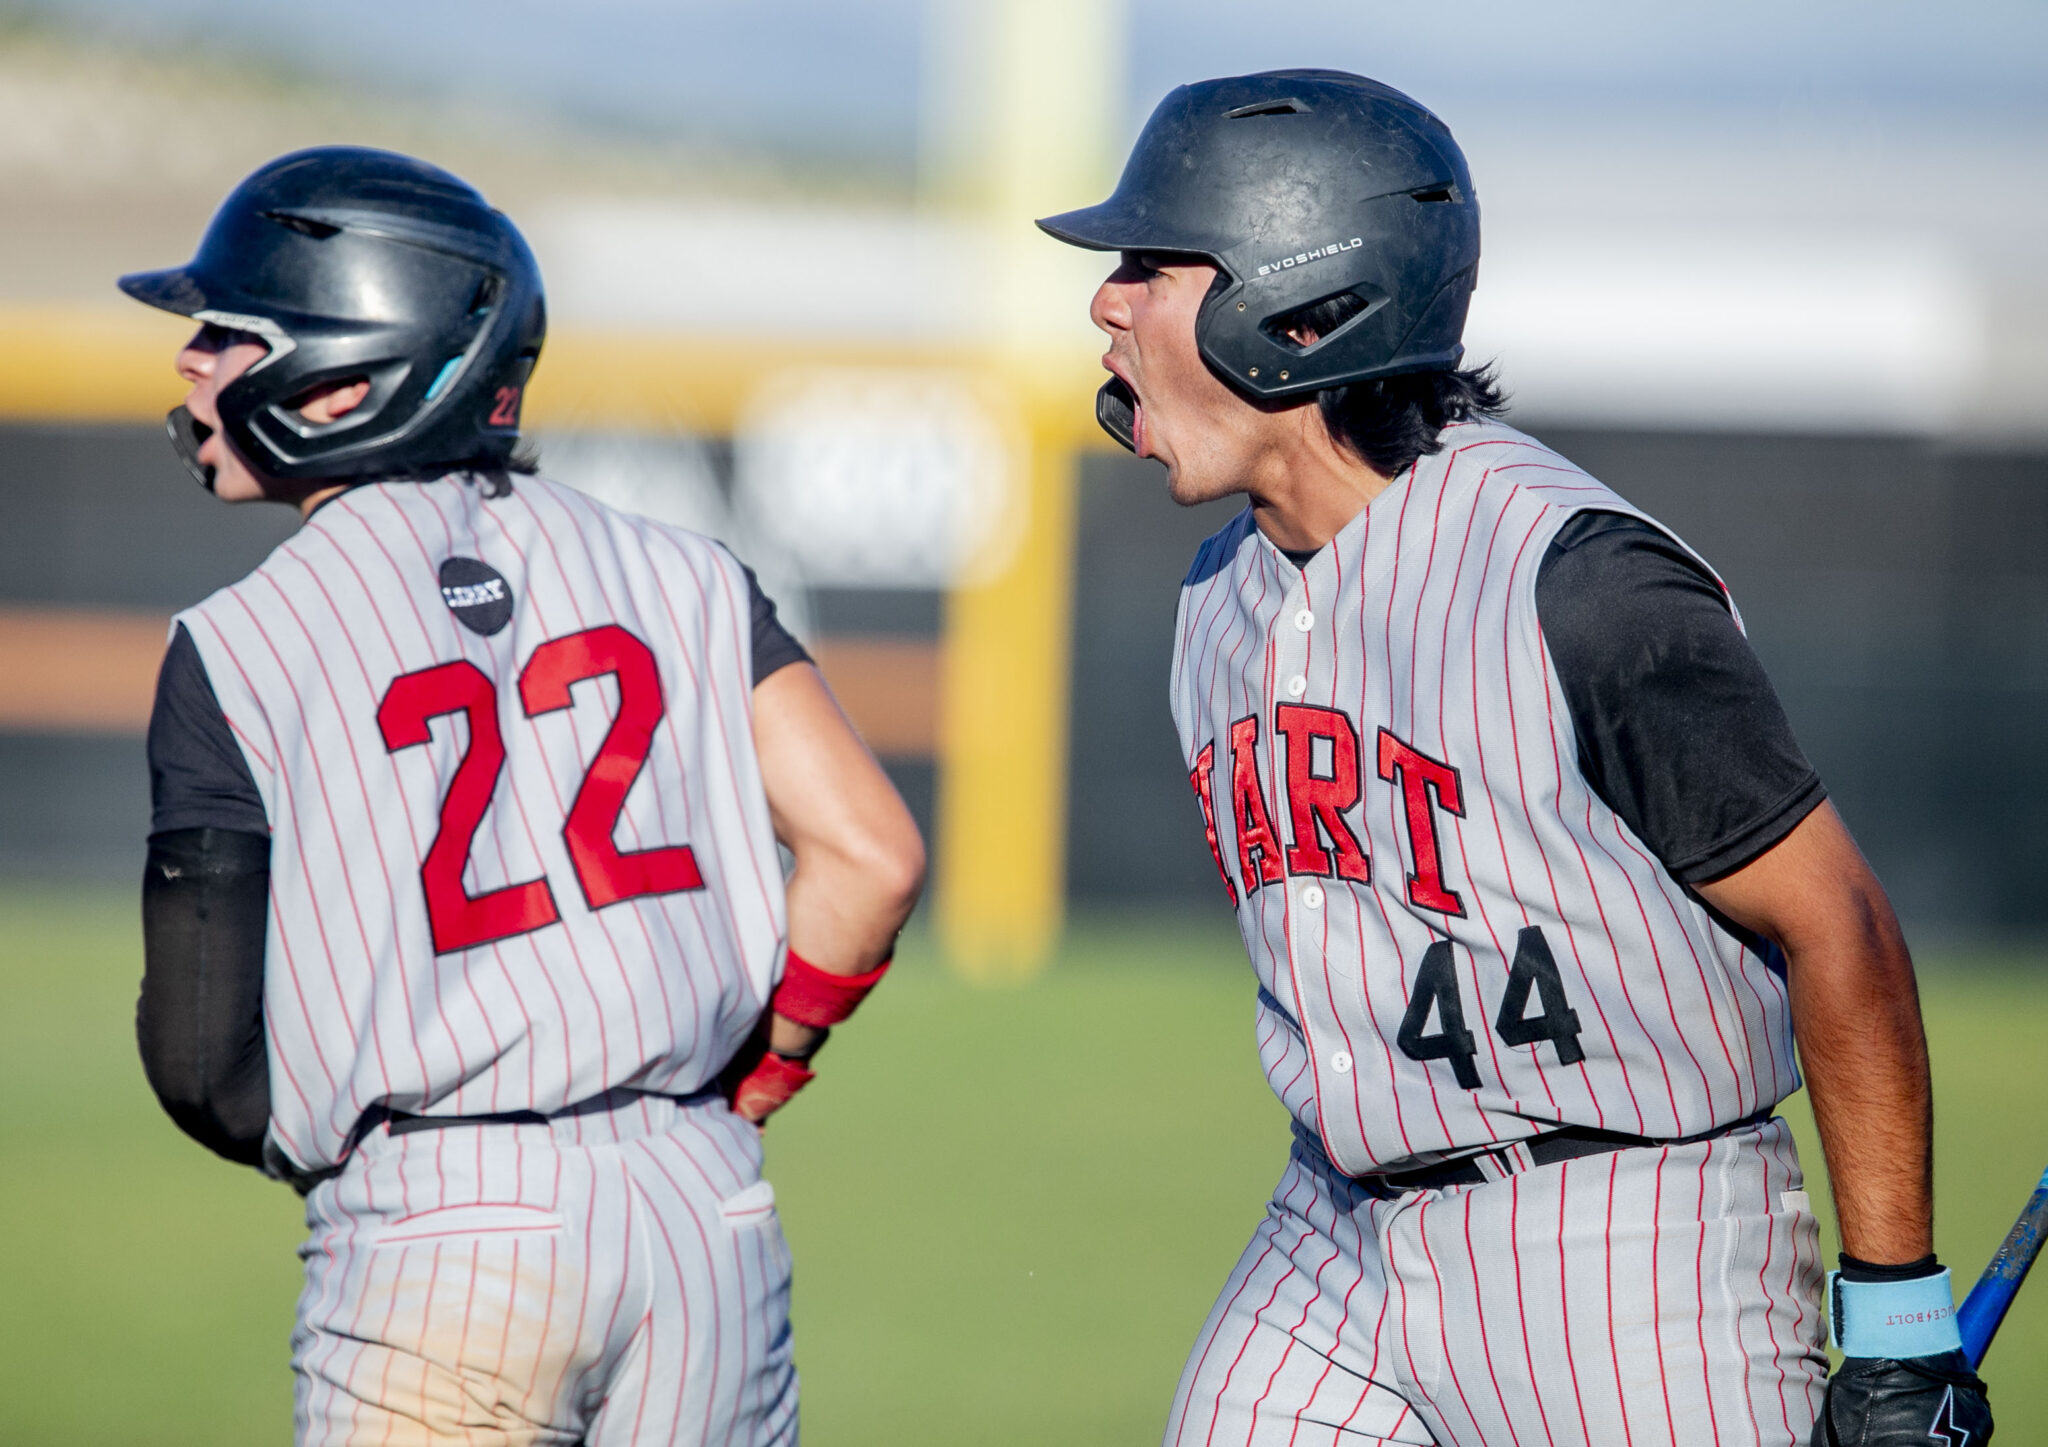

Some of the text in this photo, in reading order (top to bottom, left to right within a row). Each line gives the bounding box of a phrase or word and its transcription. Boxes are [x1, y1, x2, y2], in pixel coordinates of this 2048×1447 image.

[1257, 237, 1363, 276] EVOSHIELD
[376, 623, 706, 956] 22
[1397, 925, 1586, 1090] 44
[1886, 1312, 1925, 1326] BOLT
